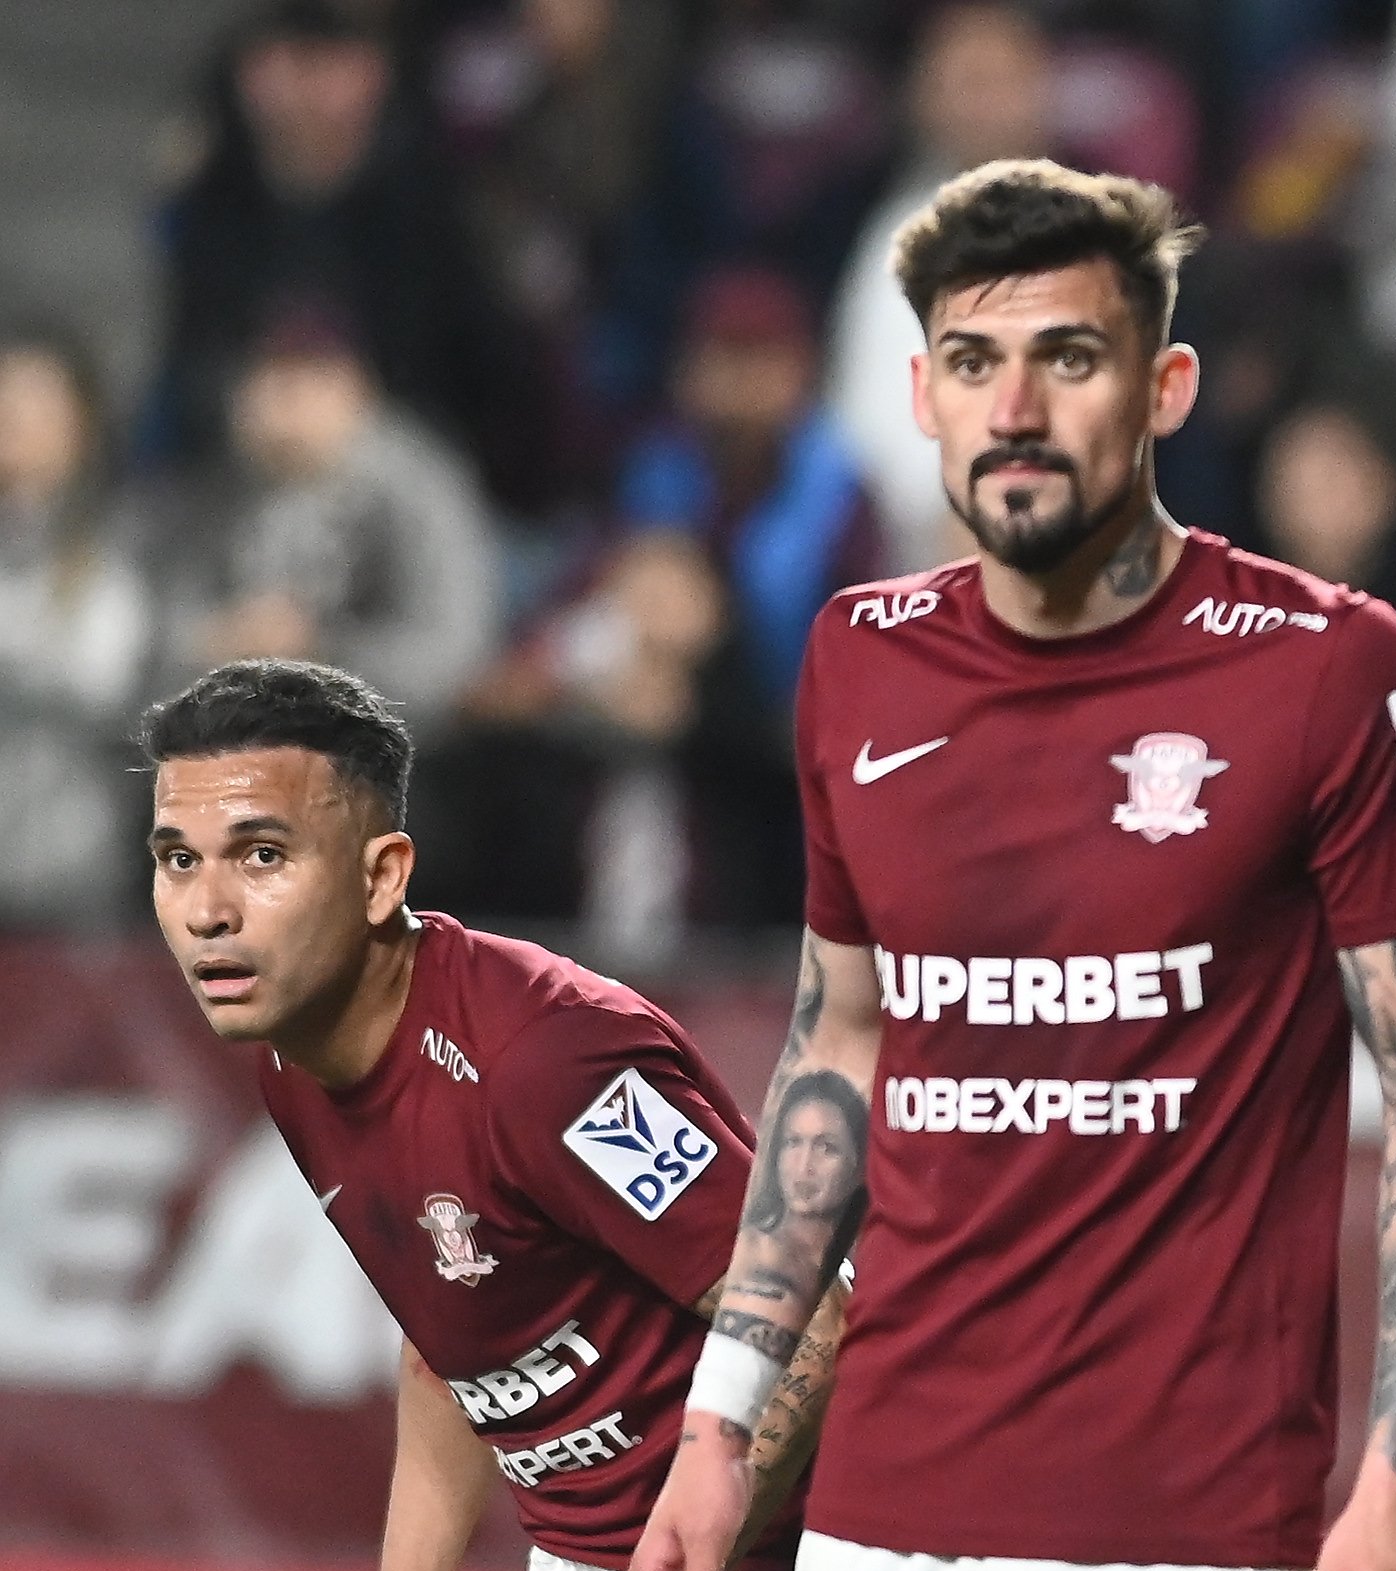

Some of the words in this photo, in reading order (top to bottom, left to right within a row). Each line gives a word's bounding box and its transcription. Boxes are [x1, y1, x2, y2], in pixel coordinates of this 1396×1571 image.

[849, 589, 942, 629] PLUS
[874, 943, 1213, 1025] UPERBET
[627, 1127, 709, 1212] DSC
